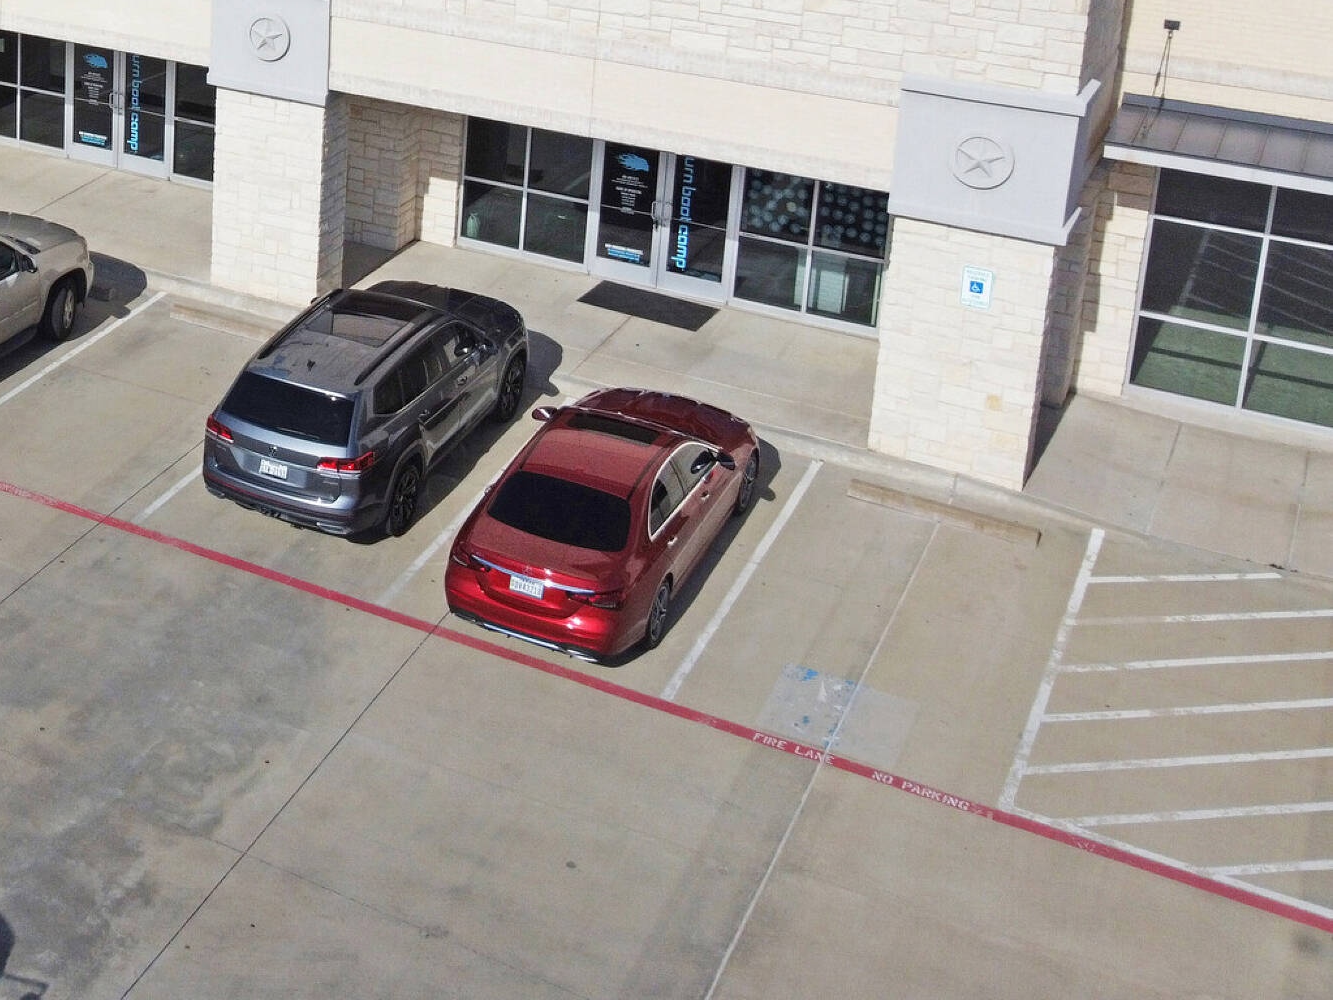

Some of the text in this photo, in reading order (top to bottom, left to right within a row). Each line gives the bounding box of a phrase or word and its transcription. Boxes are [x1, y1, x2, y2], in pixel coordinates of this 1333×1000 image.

[127, 113, 140, 151] camp
[682, 156, 695, 184] urn
[670, 224, 690, 270] camp
[753, 731, 971, 812] FIRE LANE NO PARKING
